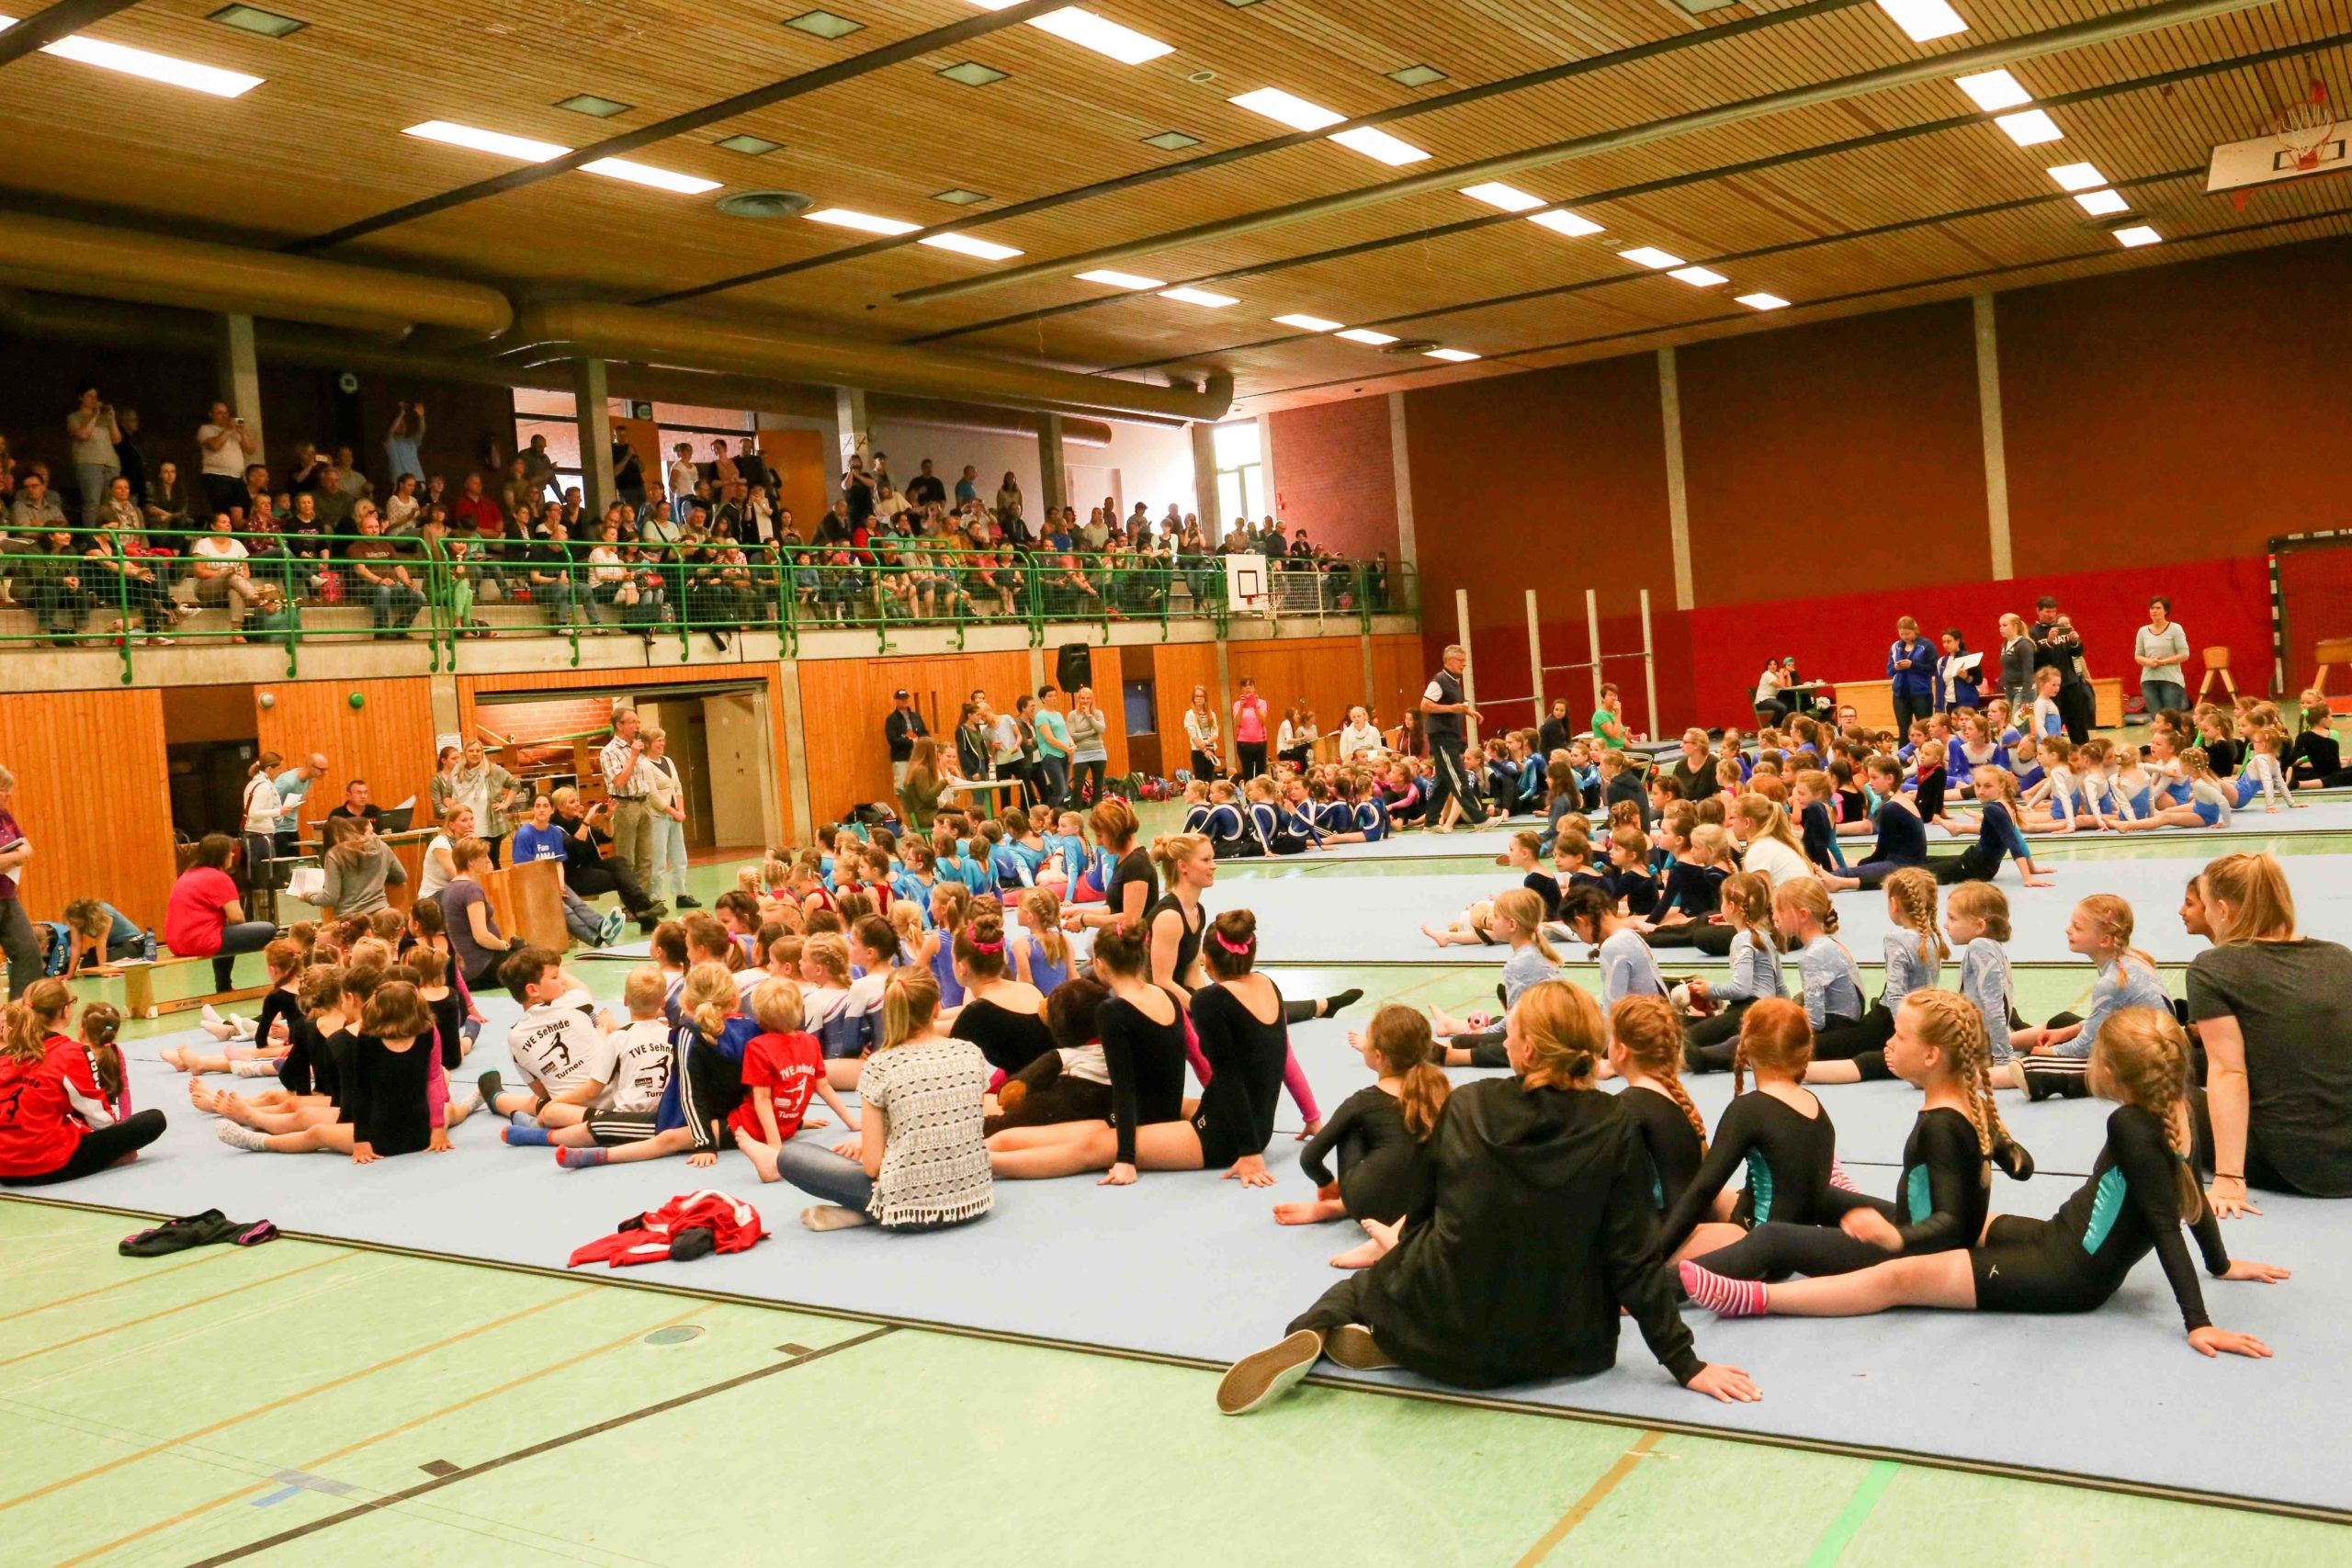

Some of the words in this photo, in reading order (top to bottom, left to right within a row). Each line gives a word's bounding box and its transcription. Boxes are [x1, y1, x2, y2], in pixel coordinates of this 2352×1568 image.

[522, 1036, 537, 1053] TVE
[537, 1020, 570, 1039] Sehnde
[628, 1044, 647, 1058] TVE
[555, 1059, 584, 1079] Turnen
[780, 1066, 796, 1080] TVE
